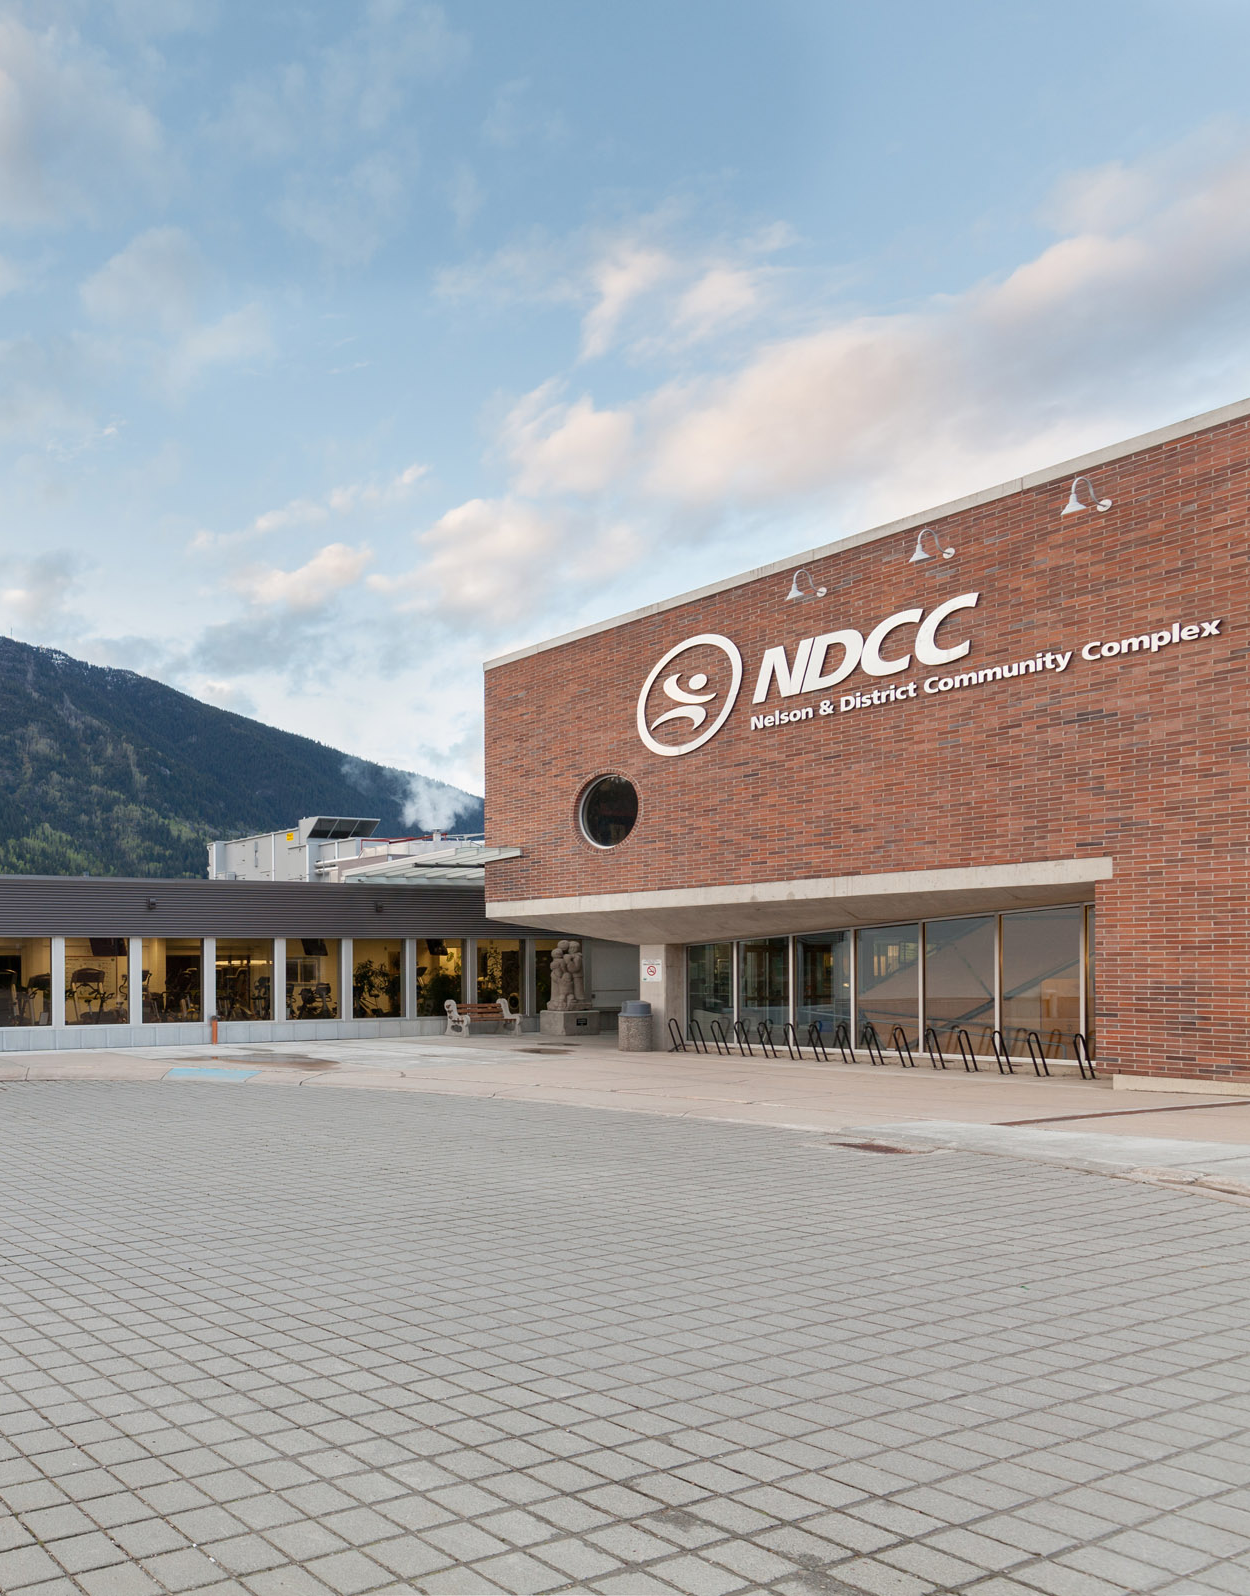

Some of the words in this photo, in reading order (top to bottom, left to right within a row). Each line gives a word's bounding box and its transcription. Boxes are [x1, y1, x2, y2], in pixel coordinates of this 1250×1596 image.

[750, 708, 814, 731] Nelson
[819, 699, 834, 716] &
[840, 682, 917, 713] District
[923, 651, 1073, 694] Community
[1081, 619, 1221, 661] Complex
[751, 591, 980, 705] NDCC
